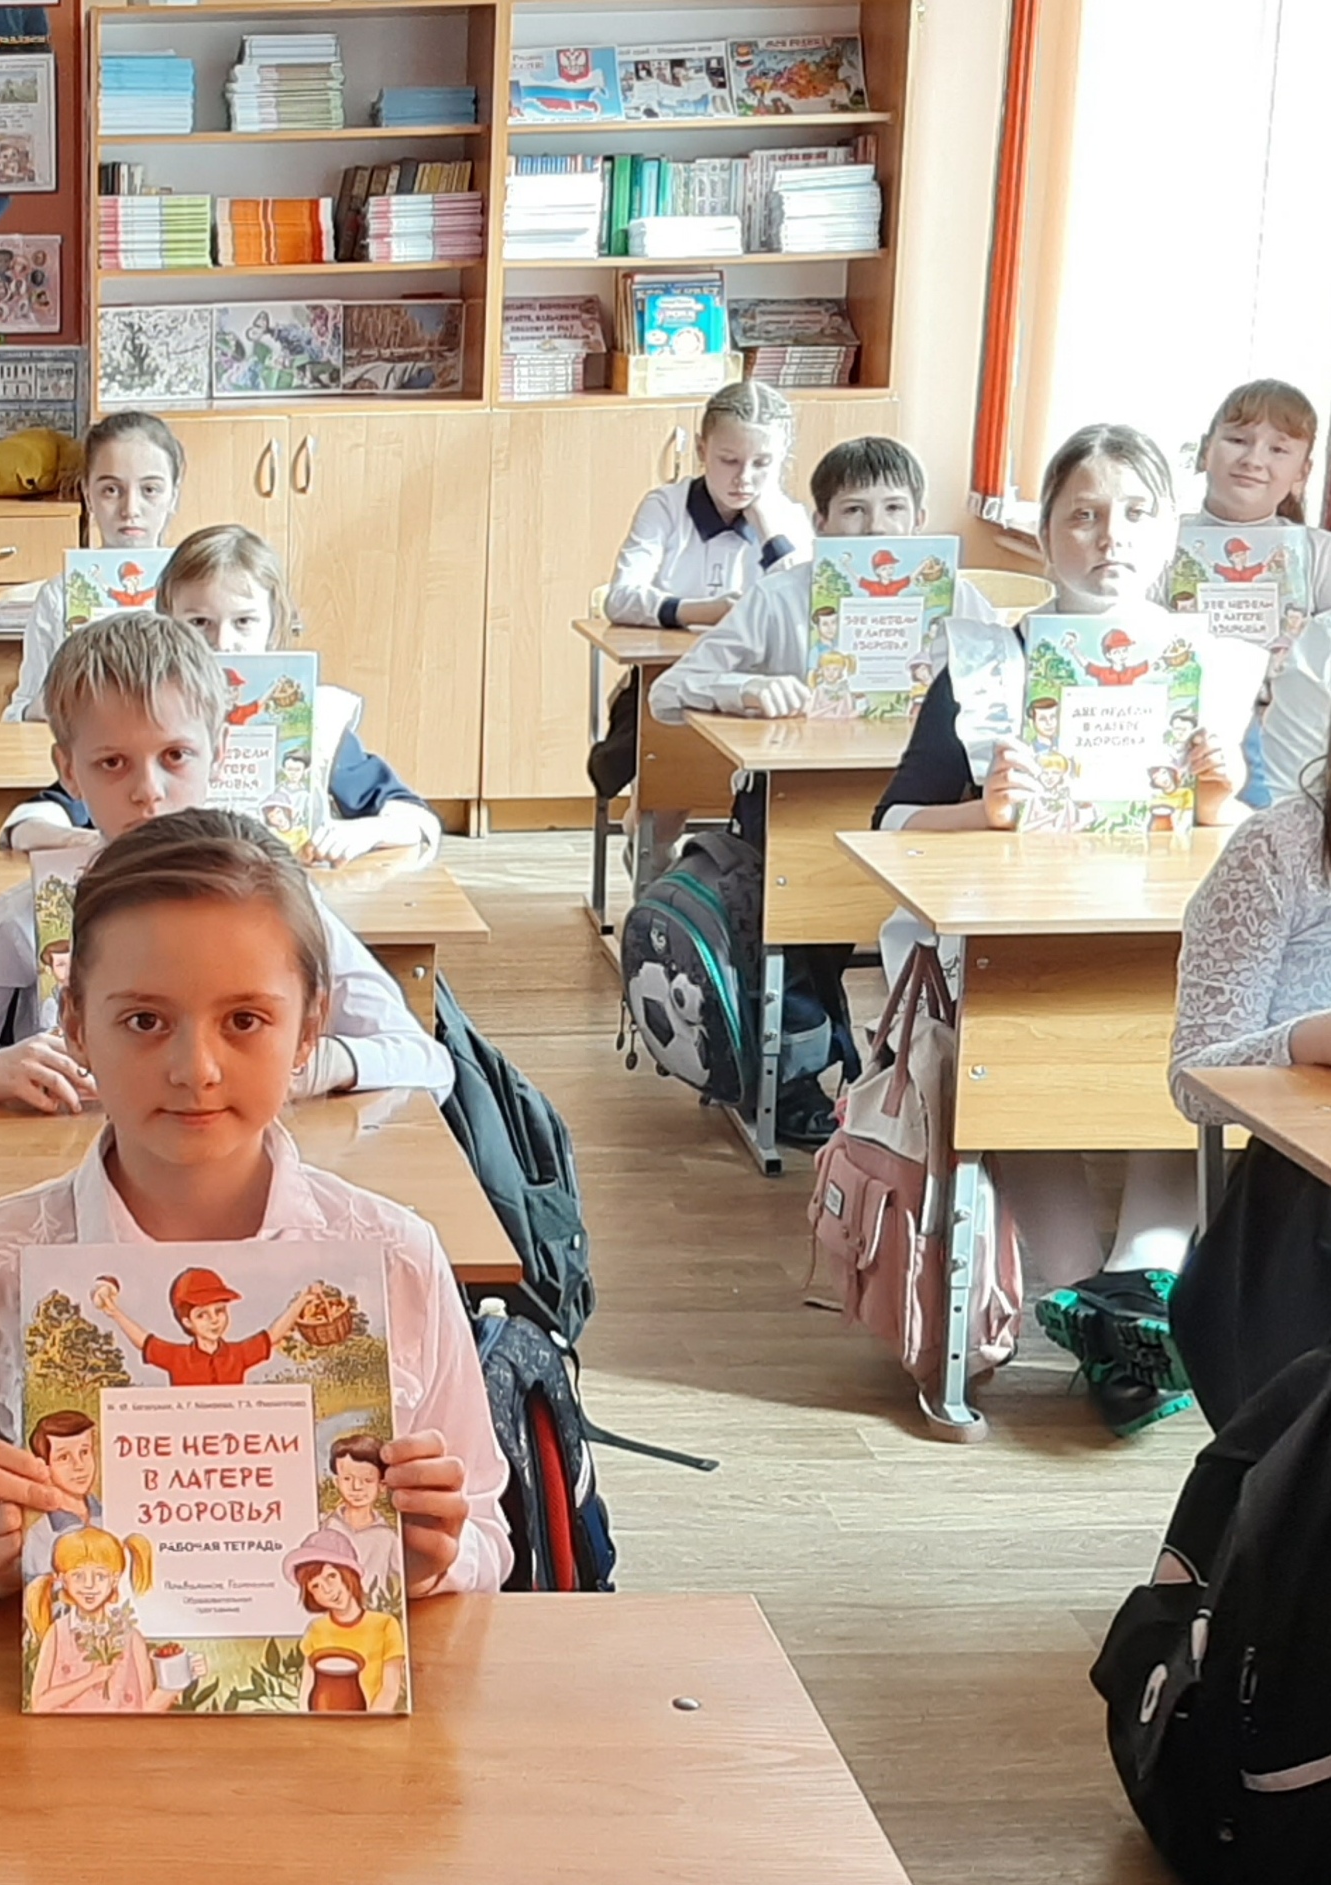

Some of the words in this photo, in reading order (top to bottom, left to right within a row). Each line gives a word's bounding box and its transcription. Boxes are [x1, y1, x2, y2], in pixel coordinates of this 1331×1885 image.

[224, 748, 269, 760] ЕДЕЛИ
[224, 764, 256, 774] ГЕРЕ
[113, 1435, 172, 1458] ДВЕ
[182, 1432, 299, 1456] НЕДЕЛИ
[142, 1468, 159, 1490] В
[168, 1466, 274, 1490] ЛАГЕРЕ
[138, 1500, 282, 1524] ЗДОРОВЬЯ
[159, 1541, 220, 1552] РАБОЧАЯ
[223, 1540, 283, 1552] ТЕТРАДЬ
